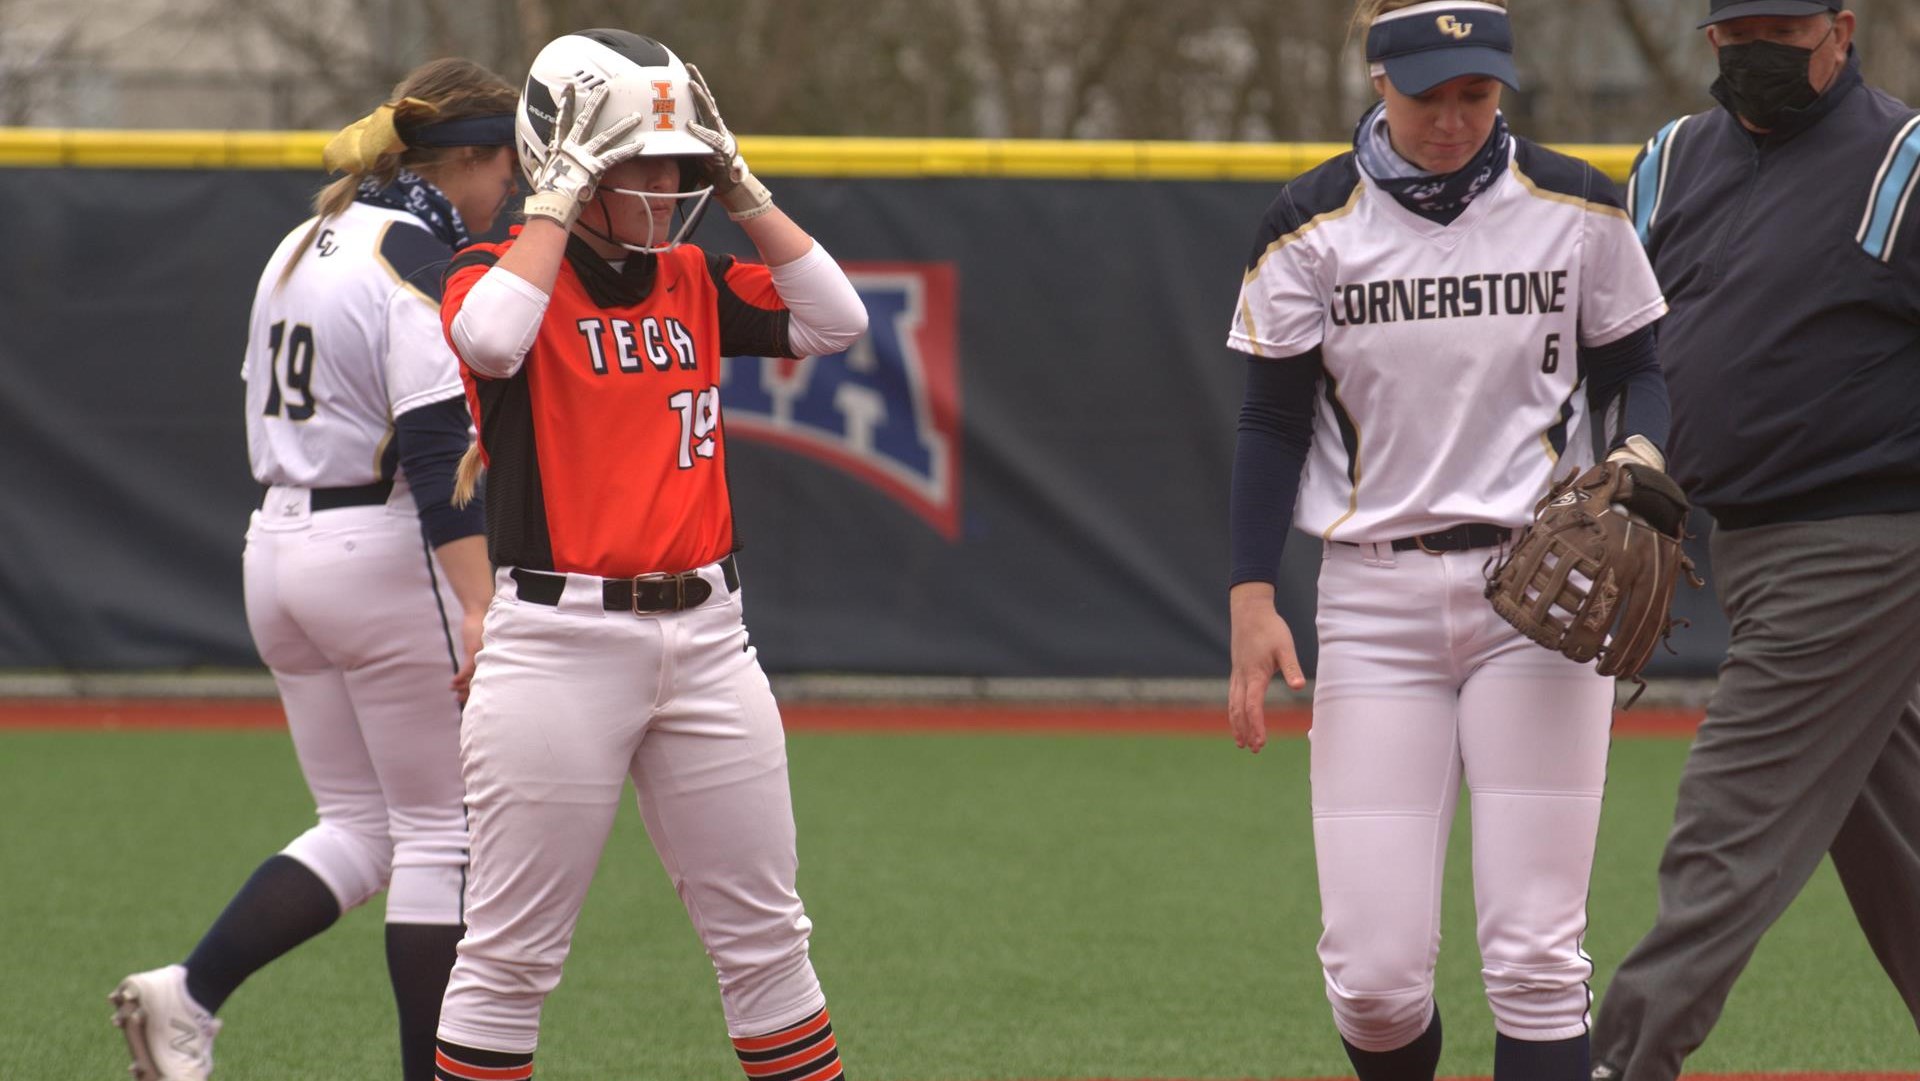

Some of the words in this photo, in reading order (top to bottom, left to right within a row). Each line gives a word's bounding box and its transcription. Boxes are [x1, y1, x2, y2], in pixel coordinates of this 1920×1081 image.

[1435, 14, 1473, 39] CU
[316, 228, 339, 258] CU
[1329, 269, 1569, 327] CORNERSTONE
[262, 318, 317, 423] 19
[576, 317, 698, 375] TECH
[1540, 332, 1561, 375] 6
[668, 384, 720, 470] 19
